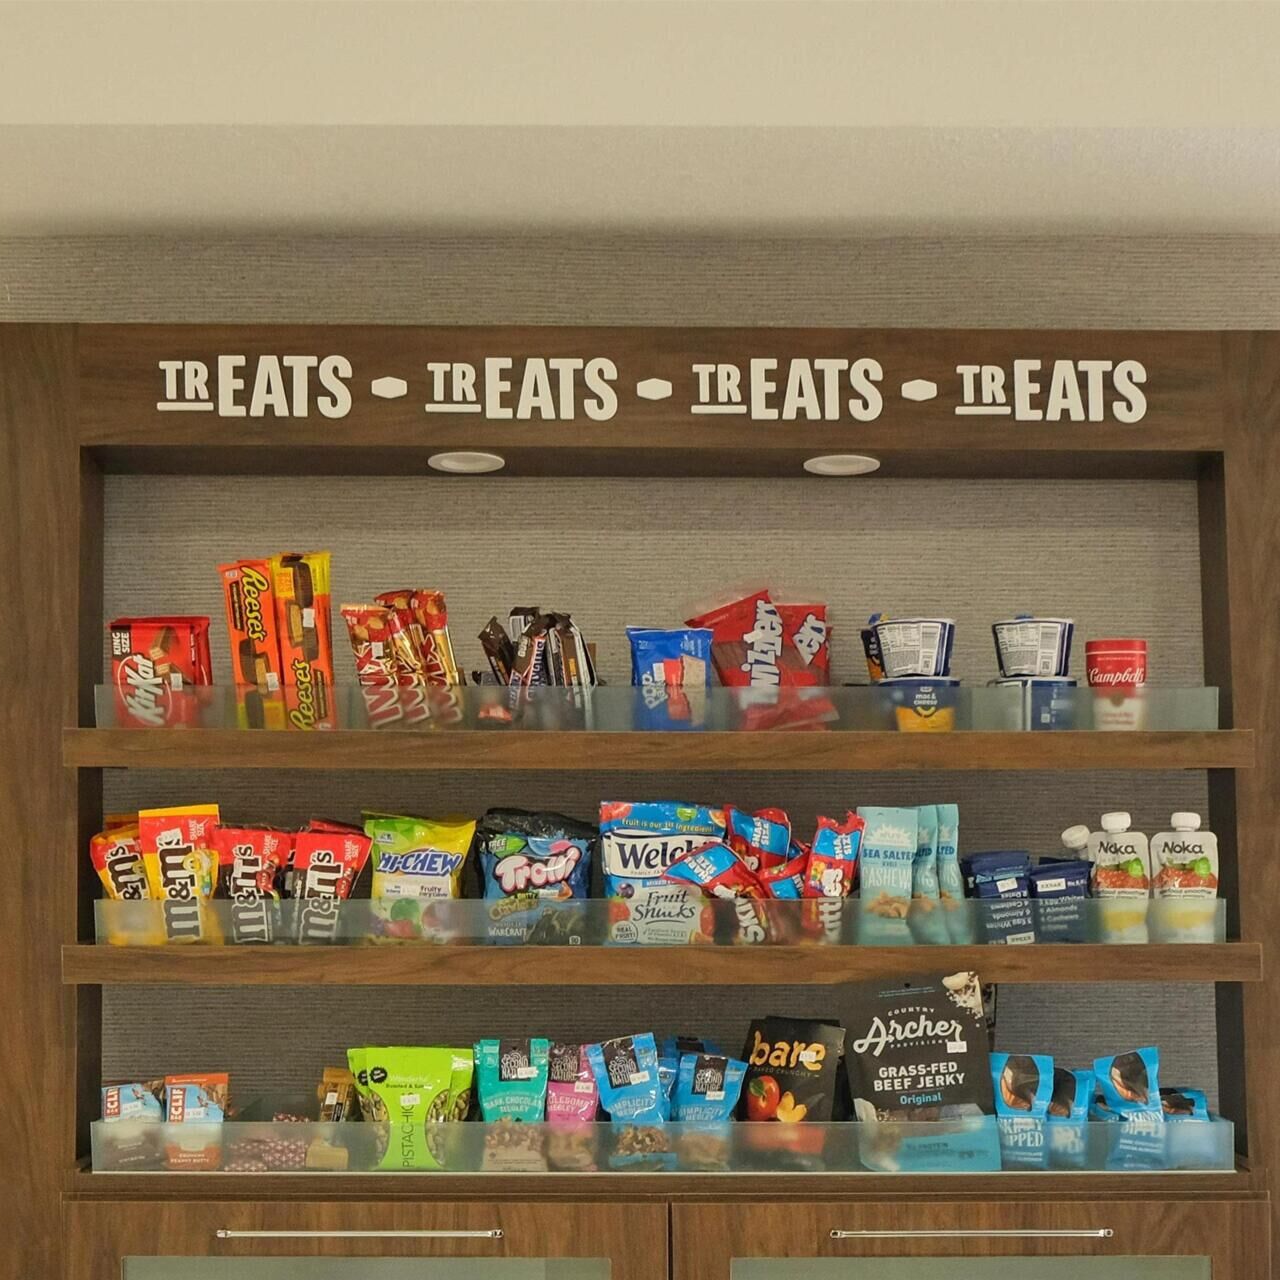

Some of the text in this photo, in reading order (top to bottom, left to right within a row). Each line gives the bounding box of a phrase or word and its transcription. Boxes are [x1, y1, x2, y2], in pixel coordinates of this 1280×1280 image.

[156, 354, 1148, 424] TREATS TREATS TREATS TREATS
[1162, 840, 1205, 855] Noka
[378, 852, 463, 877] HI-CHEW
[888, 1006, 935, 1016] COUNTRY
[853, 1014, 963, 1057] Archer
[878, 1061, 958, 1079] GRASS-FED
[873, 1072, 966, 1092] BEEF JERKY
[899, 1092, 943, 1107] Original
